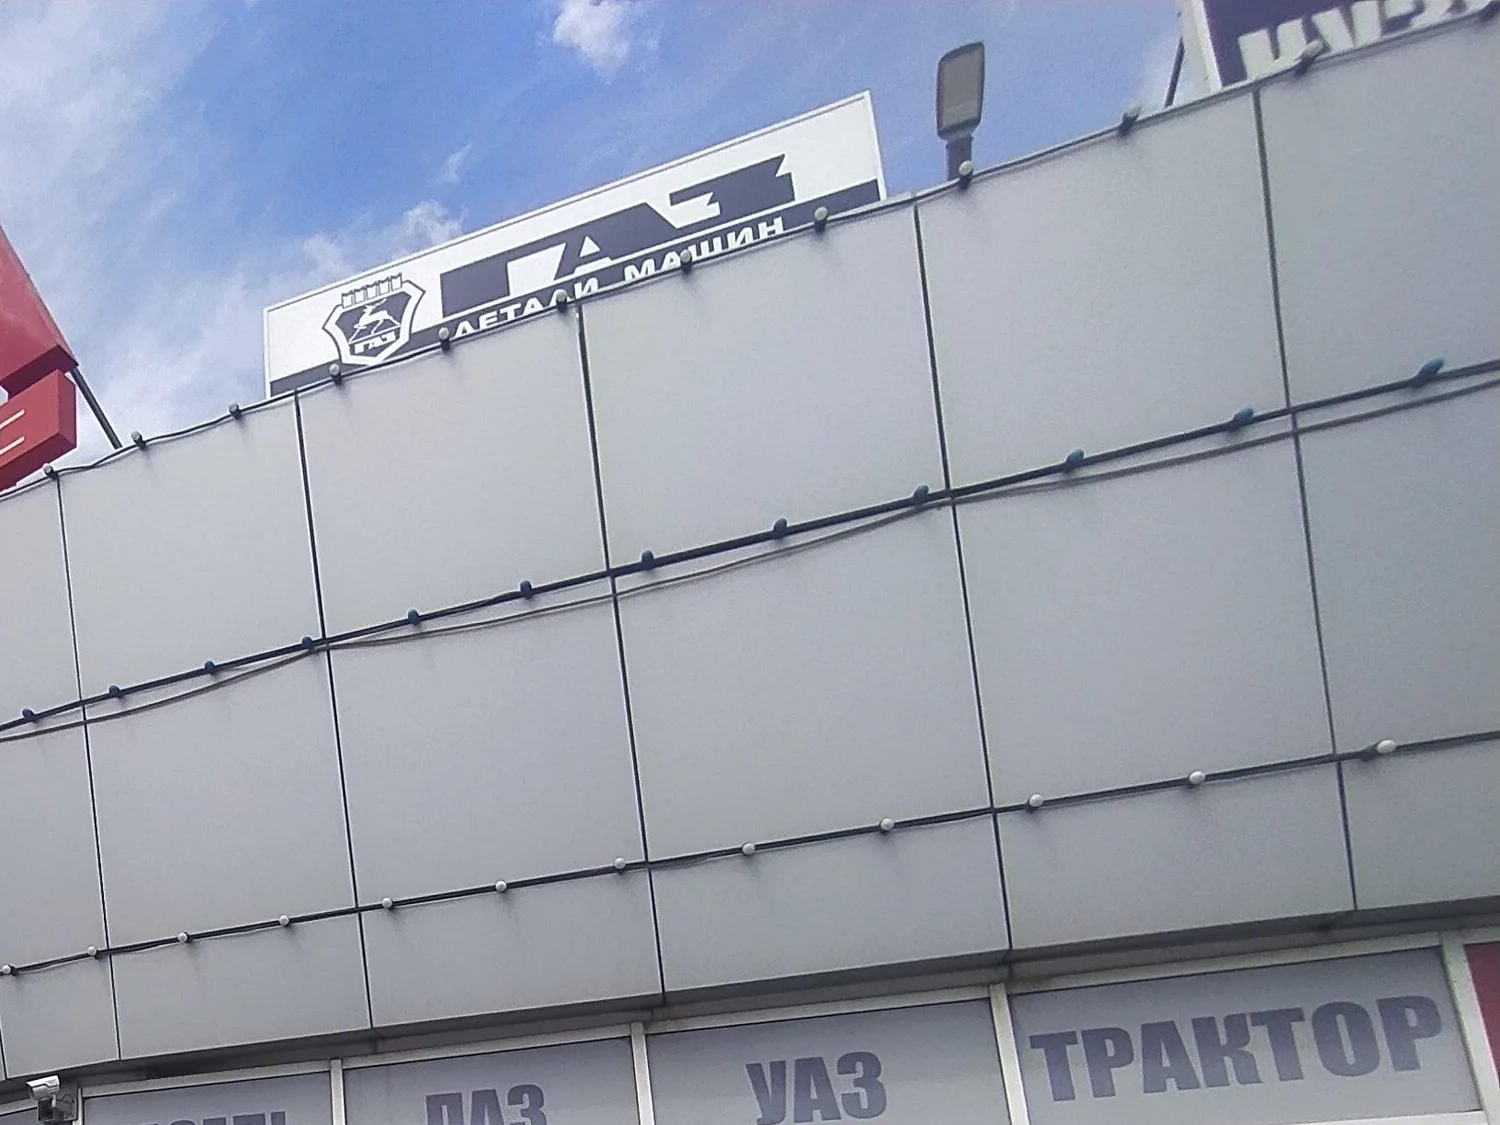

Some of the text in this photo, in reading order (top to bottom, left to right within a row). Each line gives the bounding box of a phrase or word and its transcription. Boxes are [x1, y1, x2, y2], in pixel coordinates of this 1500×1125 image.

[440, 154, 796, 318] ГАЗ
[623, 216, 784, 281] МАШИН
[1029, 995, 1444, 1102] ТРАКТОР
